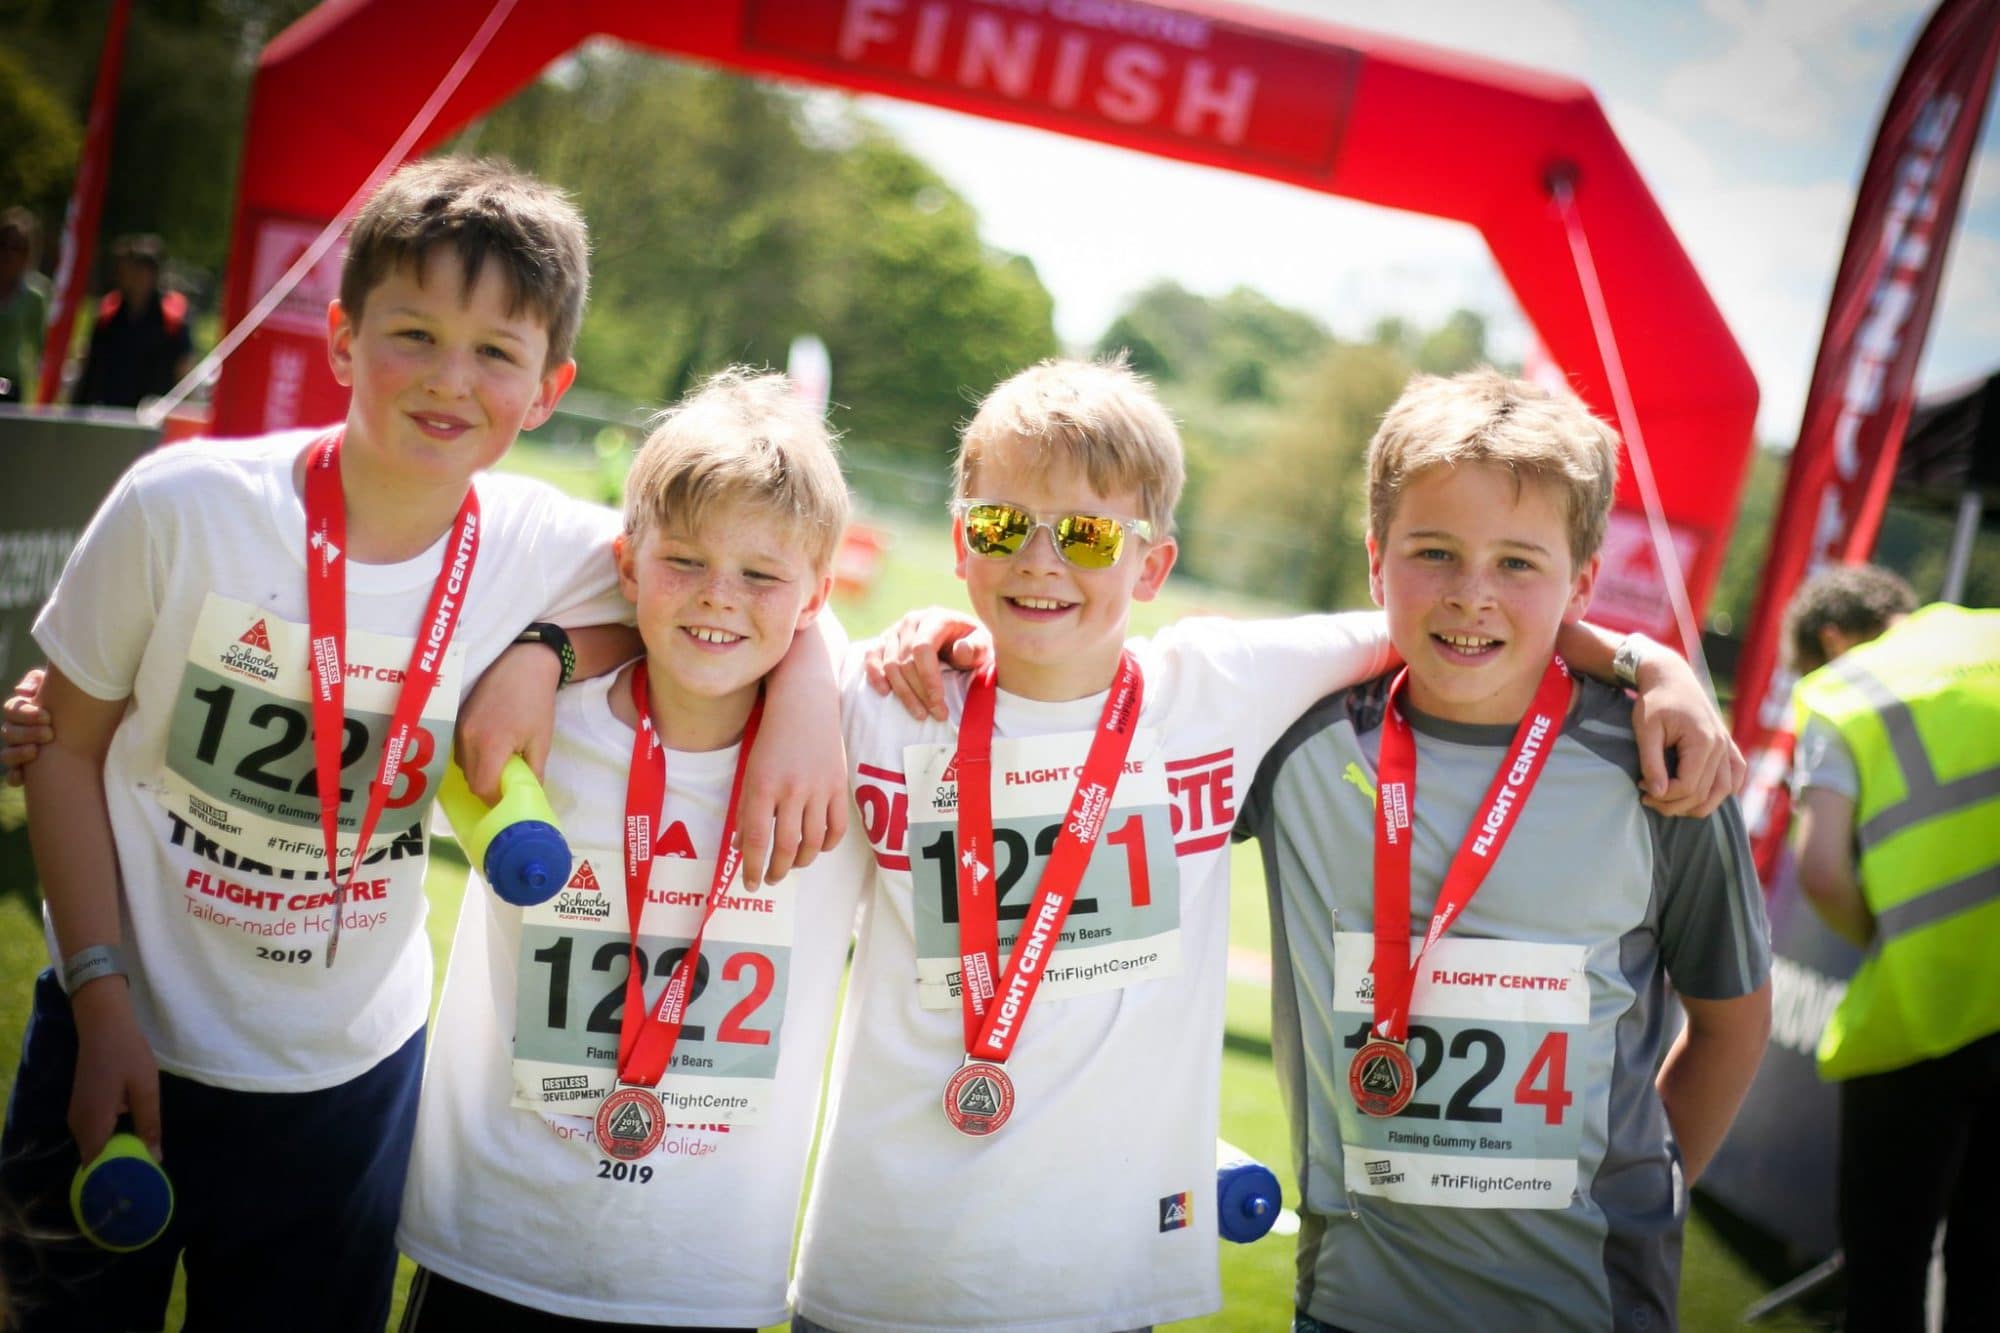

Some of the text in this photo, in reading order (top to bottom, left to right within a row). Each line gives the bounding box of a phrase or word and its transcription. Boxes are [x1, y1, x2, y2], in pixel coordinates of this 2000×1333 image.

[838, 0, 1258, 146] FINISH
[420, 512, 477, 673] FLIGHT CENTRE
[220, 655, 278, 680] TRIATHLON
[228, 645, 279, 673] Schools
[313, 639, 332, 702] DEVELOPMENT
[322, 636, 341, 684] RESTLESS
[194, 684, 436, 810] 1223
[1005, 767, 1069, 786] FLIGHT
[1472, 714, 1552, 857] FLIGHT CENTRE
[189, 806, 242, 836] DEVELOPMENT
[230, 788, 357, 827] Flaming Gummy ars
[932, 800, 958, 809] TRIAT
[1069, 783, 1103, 838] Schools
[1080, 785, 1108, 844] TRIATHLON
[1381, 783, 1398, 845] DEVELOPMENT
[1392, 783, 1409, 829] RESTLESS
[627, 815, 638, 878] DEVELOPMENT
[637, 815, 650, 861] RESTLESS
[922, 812, 1151, 923] 1221
[185, 868, 285, 912] FLIGHT
[553, 902, 610, 917] TRIATHLON
[559, 892, 610, 910] Schools
[183, 895, 296, 937] Tailor-made
[1079, 926, 1112, 941] Bears
[256, 947, 313, 964] 2019
[973, 952, 995, 999] RESTLESS
[988, 972, 1029, 1048] FLIGHT
[1019, 892, 1063, 973] CENTRE
[1041, 952, 1158, 984] TriFlightCentre
[534, 936, 776, 1046] 1222
[658, 978, 681, 1023] RESTLESS
[670, 964, 689, 1025] DEVELOPMENT
[963, 955, 984, 1015] DEVELOPMENT
[1432, 971, 1568, 991] FLIGHT CENTRE
[586, 1046, 618, 1060] Flami
[681, 1054, 713, 1069] Bears
[543, 1076, 587, 1091] RESTLESS
[543, 1089, 605, 1103] DEVELOPMENT
[1388, 1131, 1512, 1150] Flaming Gummy Bears
[597, 1160, 653, 1184] 2019
[1431, 1173, 1552, 1192] #TriFlightCentre
